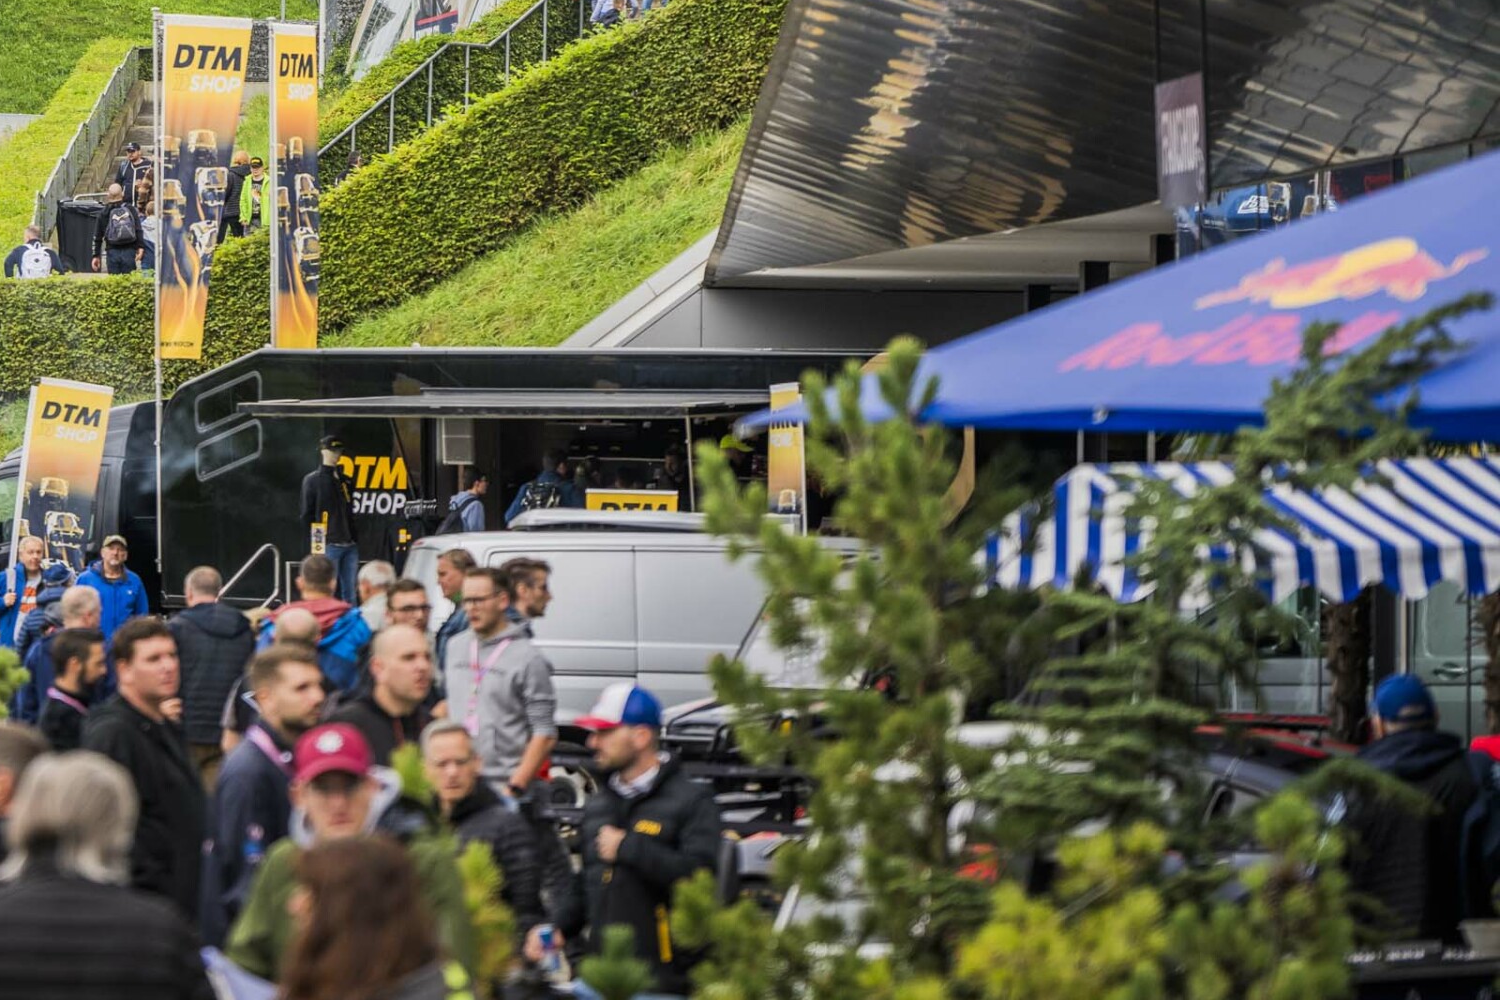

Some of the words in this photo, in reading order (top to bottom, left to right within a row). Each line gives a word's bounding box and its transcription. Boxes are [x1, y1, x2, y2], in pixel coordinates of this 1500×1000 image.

[173, 44, 242, 72] DTM
[279, 53, 314, 78] DTM
[190, 75, 241, 93] SHOP
[41, 401, 102, 428] DTM
[55, 426, 99, 444] SHOP
[336, 455, 409, 490] DTM
[352, 492, 407, 515] SHOP
